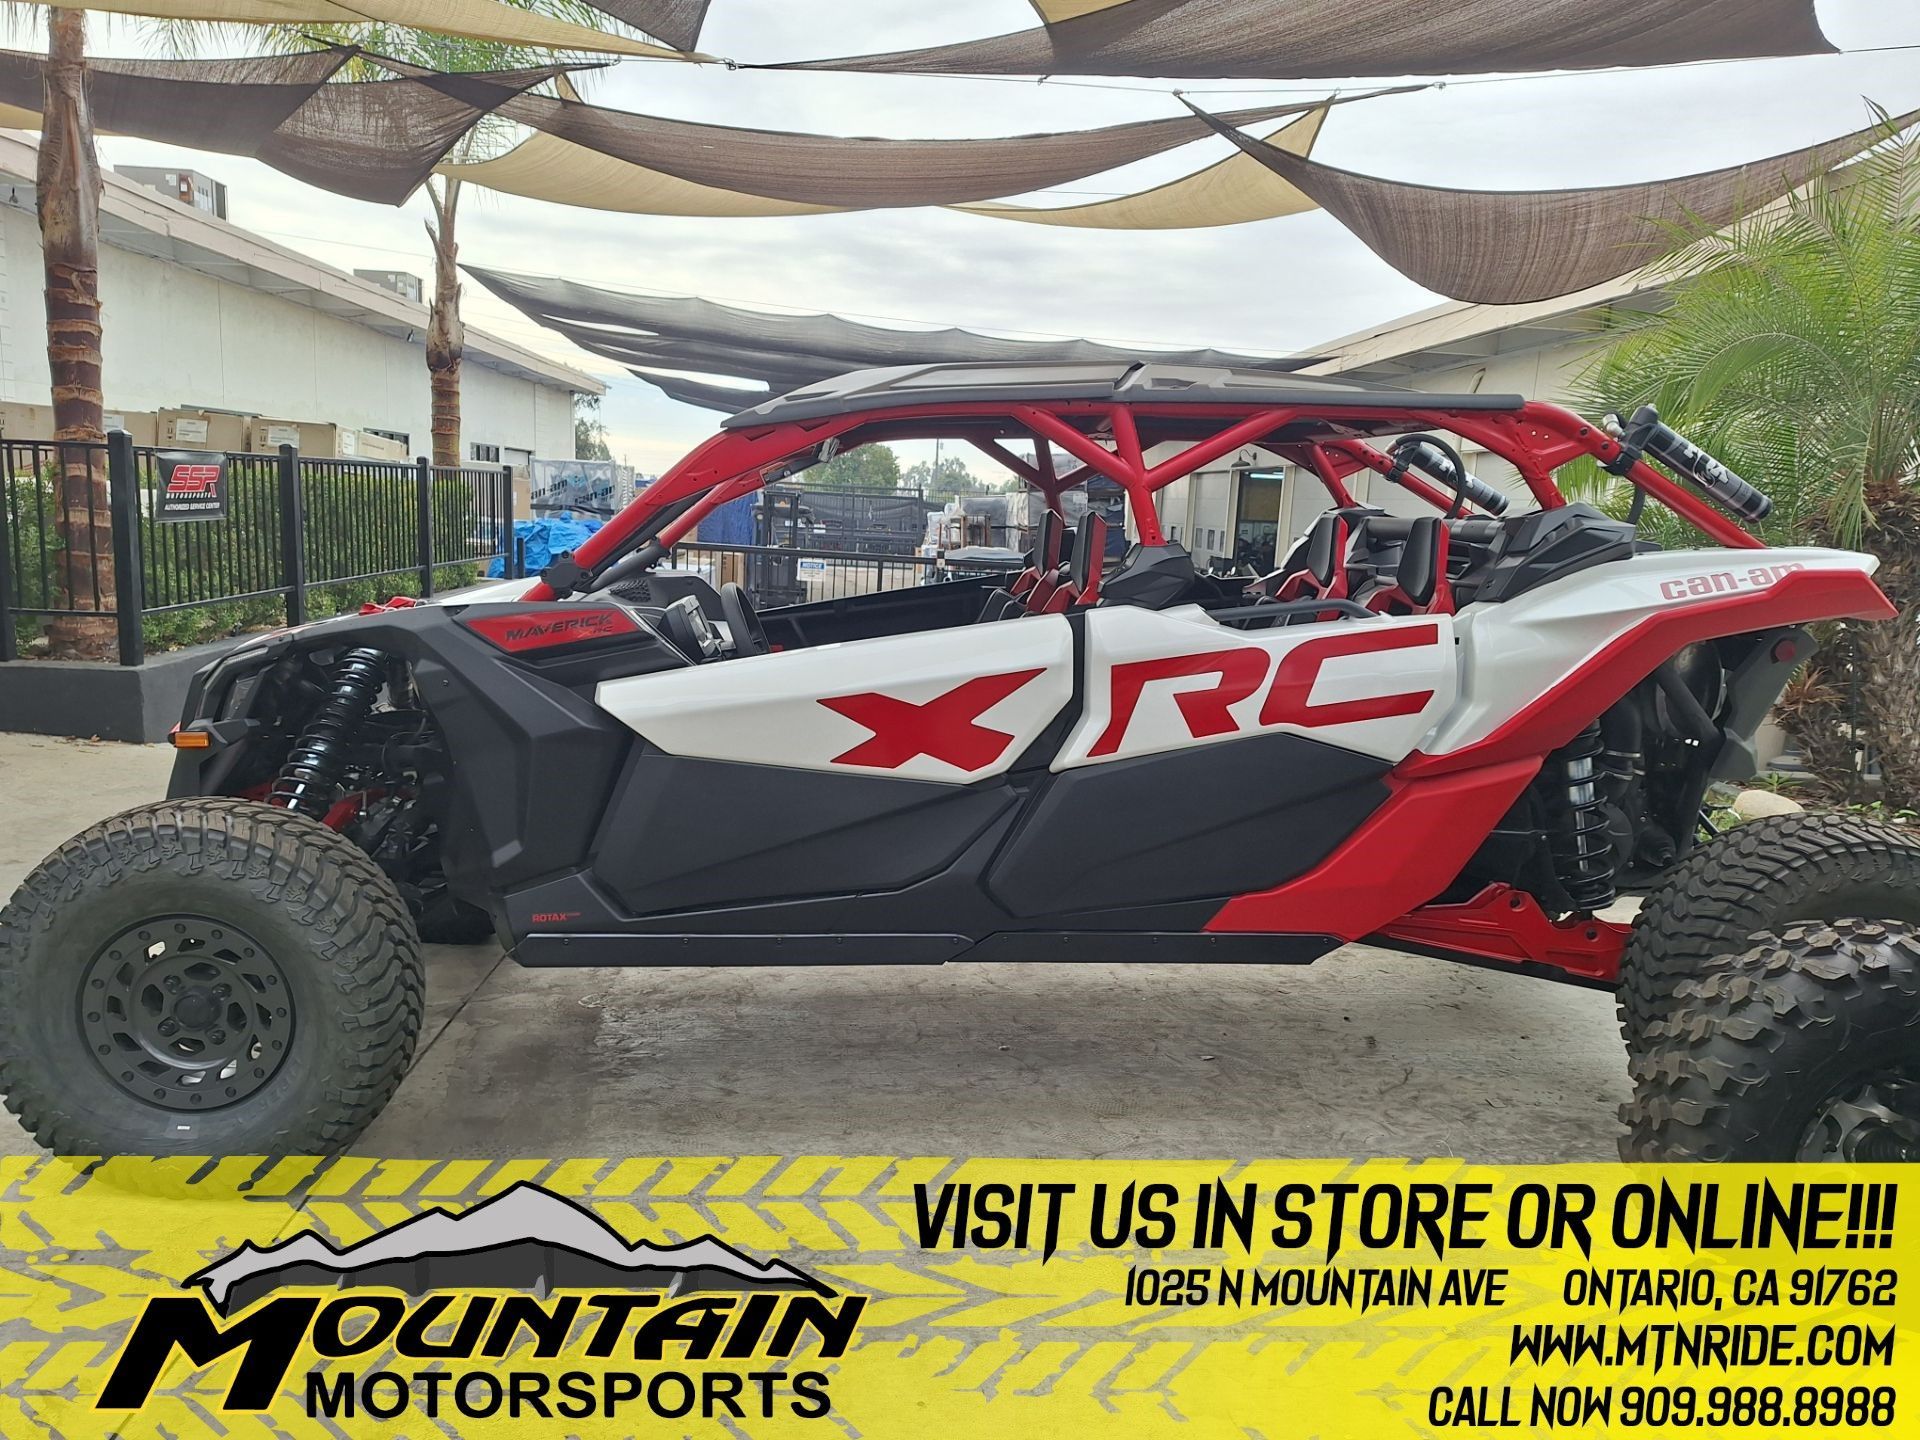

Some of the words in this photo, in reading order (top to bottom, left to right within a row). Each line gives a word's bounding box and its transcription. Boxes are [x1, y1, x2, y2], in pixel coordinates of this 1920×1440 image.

[167, 464, 220, 497] SSR
[531, 479, 568, 500] an-am
[506, 613, 614, 641] MAVERICK
[532, 913, 567, 923] ROTAX
